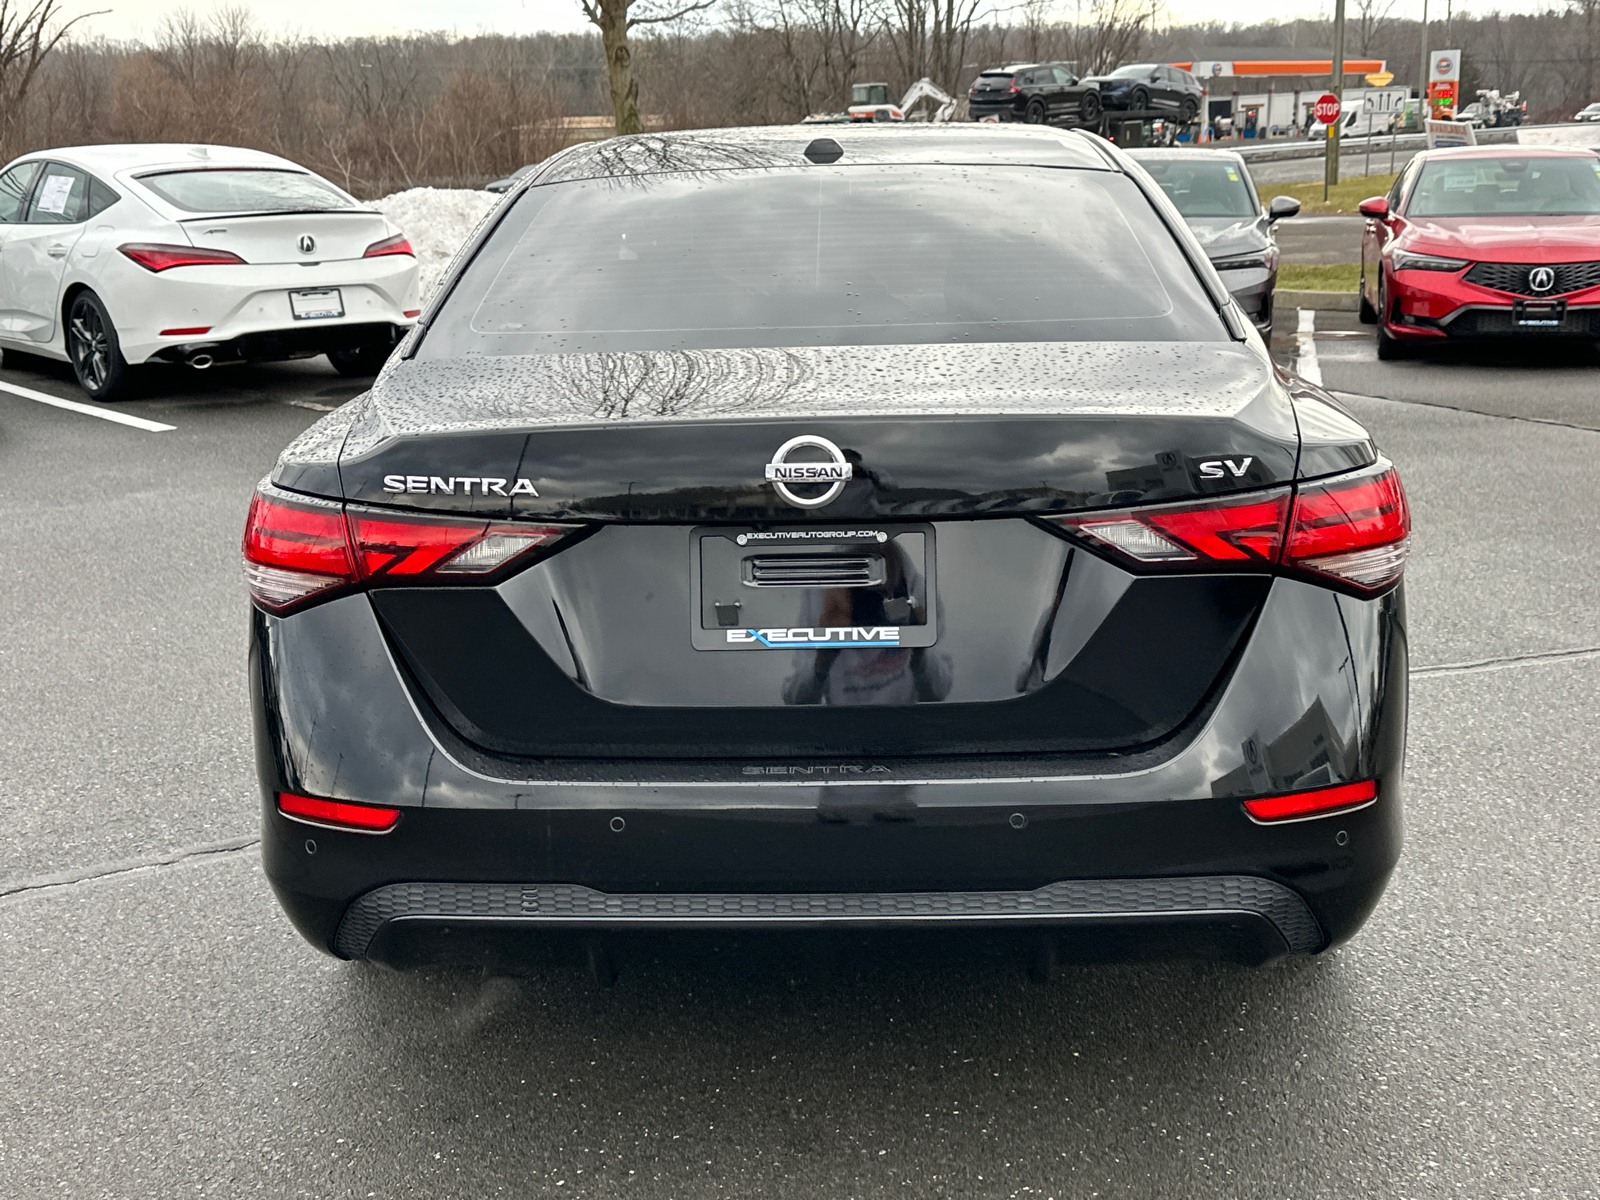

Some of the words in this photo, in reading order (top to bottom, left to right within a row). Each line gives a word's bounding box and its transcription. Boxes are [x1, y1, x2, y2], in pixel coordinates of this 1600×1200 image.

[1316, 103, 1340, 116] STOP
[774, 467, 843, 478] NISSAN
[1199, 457, 1253, 479] SV
[383, 474, 539, 498] SENTRA
[746, 530, 878, 540] EXECUTIVEAUTOGROUP.COM
[726, 626, 900, 644] EXECUTIVE
[741, 764, 892, 775] SENTRA
